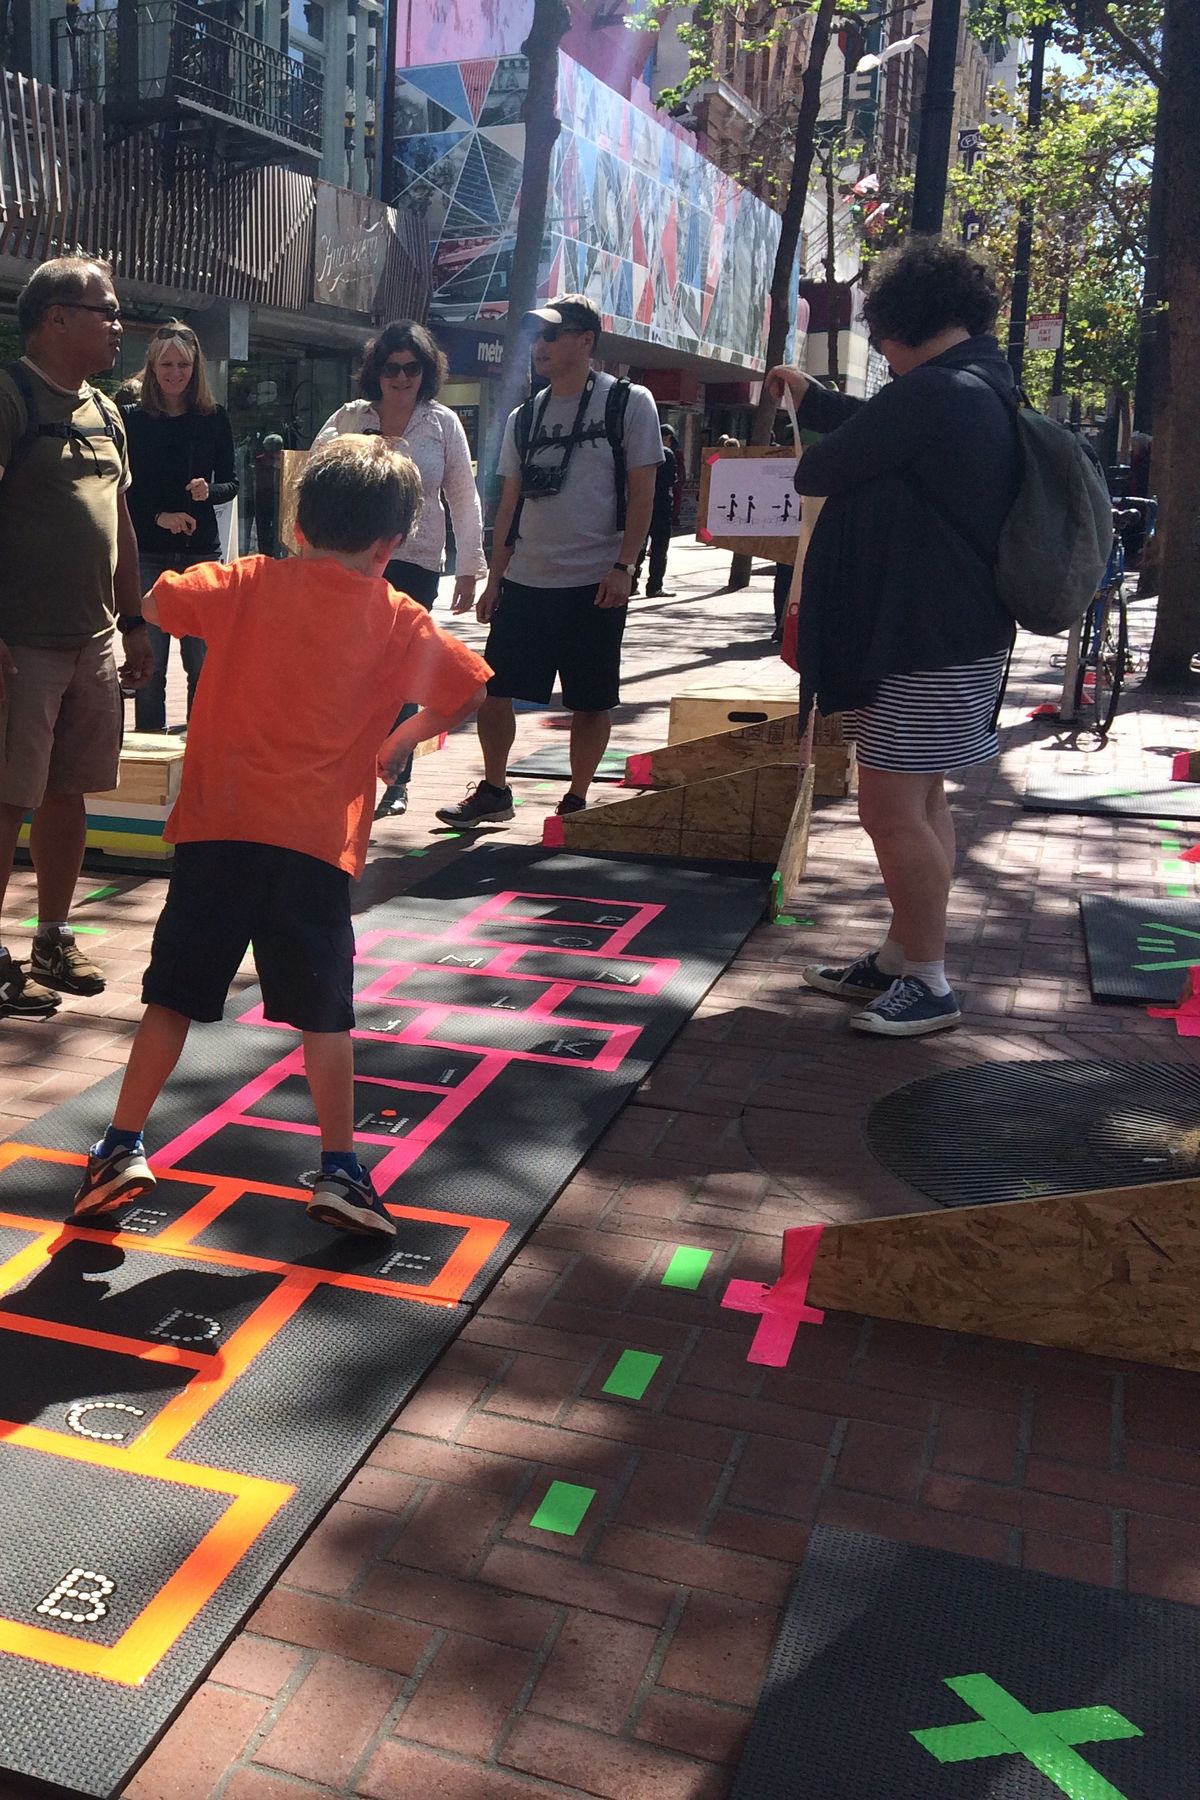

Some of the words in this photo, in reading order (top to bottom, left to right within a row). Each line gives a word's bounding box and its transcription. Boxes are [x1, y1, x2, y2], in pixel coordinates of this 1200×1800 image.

[435, 954, 485, 968] M
[490, 996, 517, 1010] L
[551, 1038, 591, 1056] K
[353, 1113, 411, 1134] H
[117, 1207, 168, 1233] E
[376, 1251, 432, 1275] F
[147, 1308, 222, 1343] D
[65, 1400, 146, 1441] C
[33, 1566, 117, 1623] B
